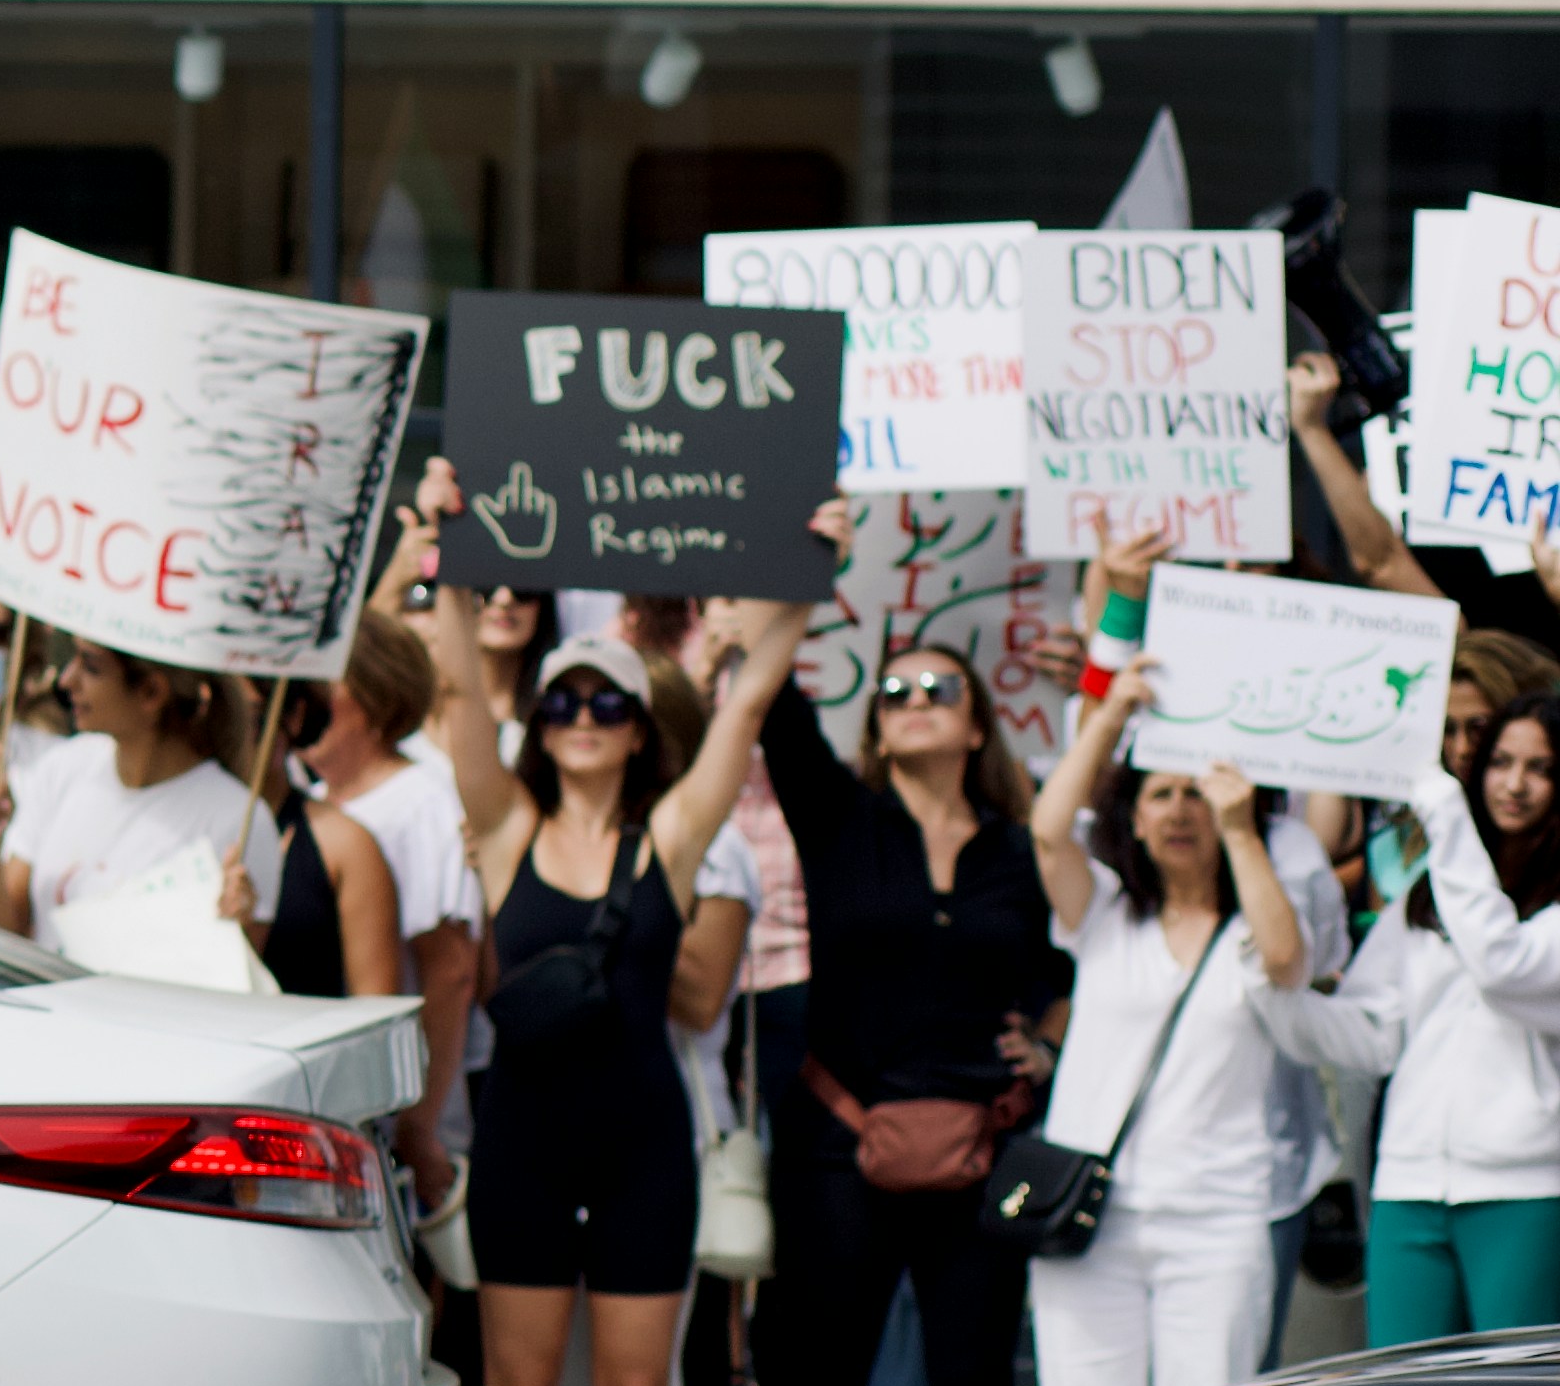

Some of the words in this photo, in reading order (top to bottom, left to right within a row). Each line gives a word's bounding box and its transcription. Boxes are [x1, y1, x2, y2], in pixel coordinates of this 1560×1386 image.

[21, 266, 80, 336] BE
[1070, 241, 1256, 314] BIDEN
[524, 324, 795, 410] FUCK
[843, 315, 931, 356] VES
[1063, 318, 1217, 389] STOP
[2, 350, 145, 455] OUR
[1026, 390, 1289, 447] NEGOTIATING
[620, 421, 684, 457] the
[1041, 450, 1149, 485] WITH
[1178, 446, 1251, 490] THE
[582, 466, 747, 504] Islamic
[1068, 488, 1251, 552] REGIME
